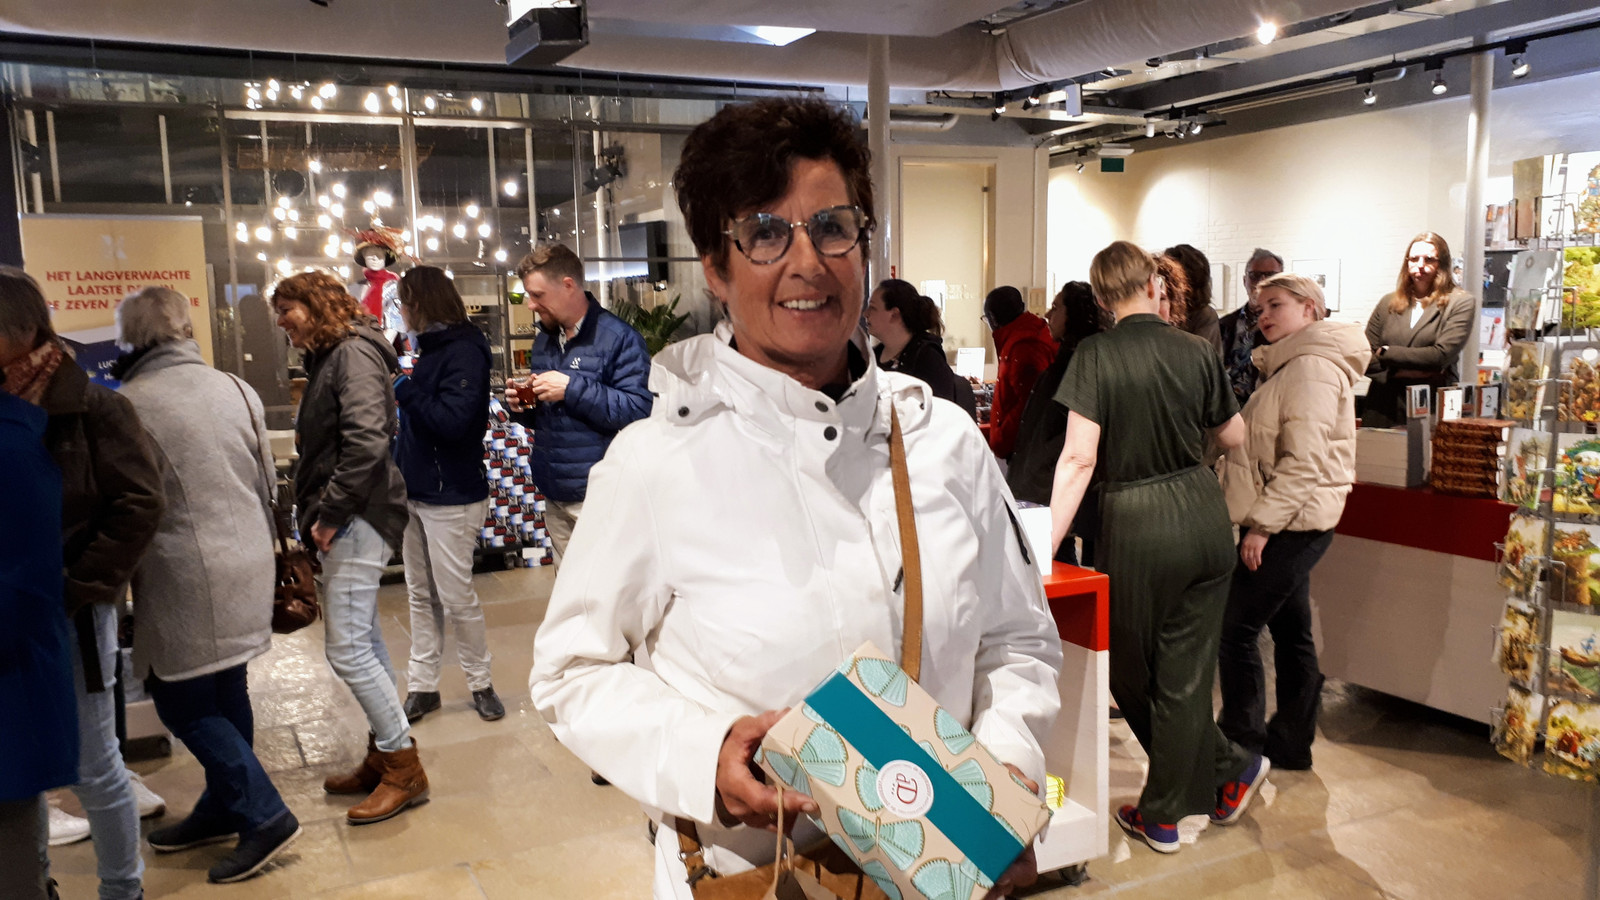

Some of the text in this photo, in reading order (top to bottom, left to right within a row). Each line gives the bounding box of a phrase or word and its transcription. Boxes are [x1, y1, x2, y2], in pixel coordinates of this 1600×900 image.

[47, 270, 191, 281] HET LANGVERWACHTE
[68, 284, 123, 296] LAATSTE
[65, 299, 108, 310] ZEVEN
